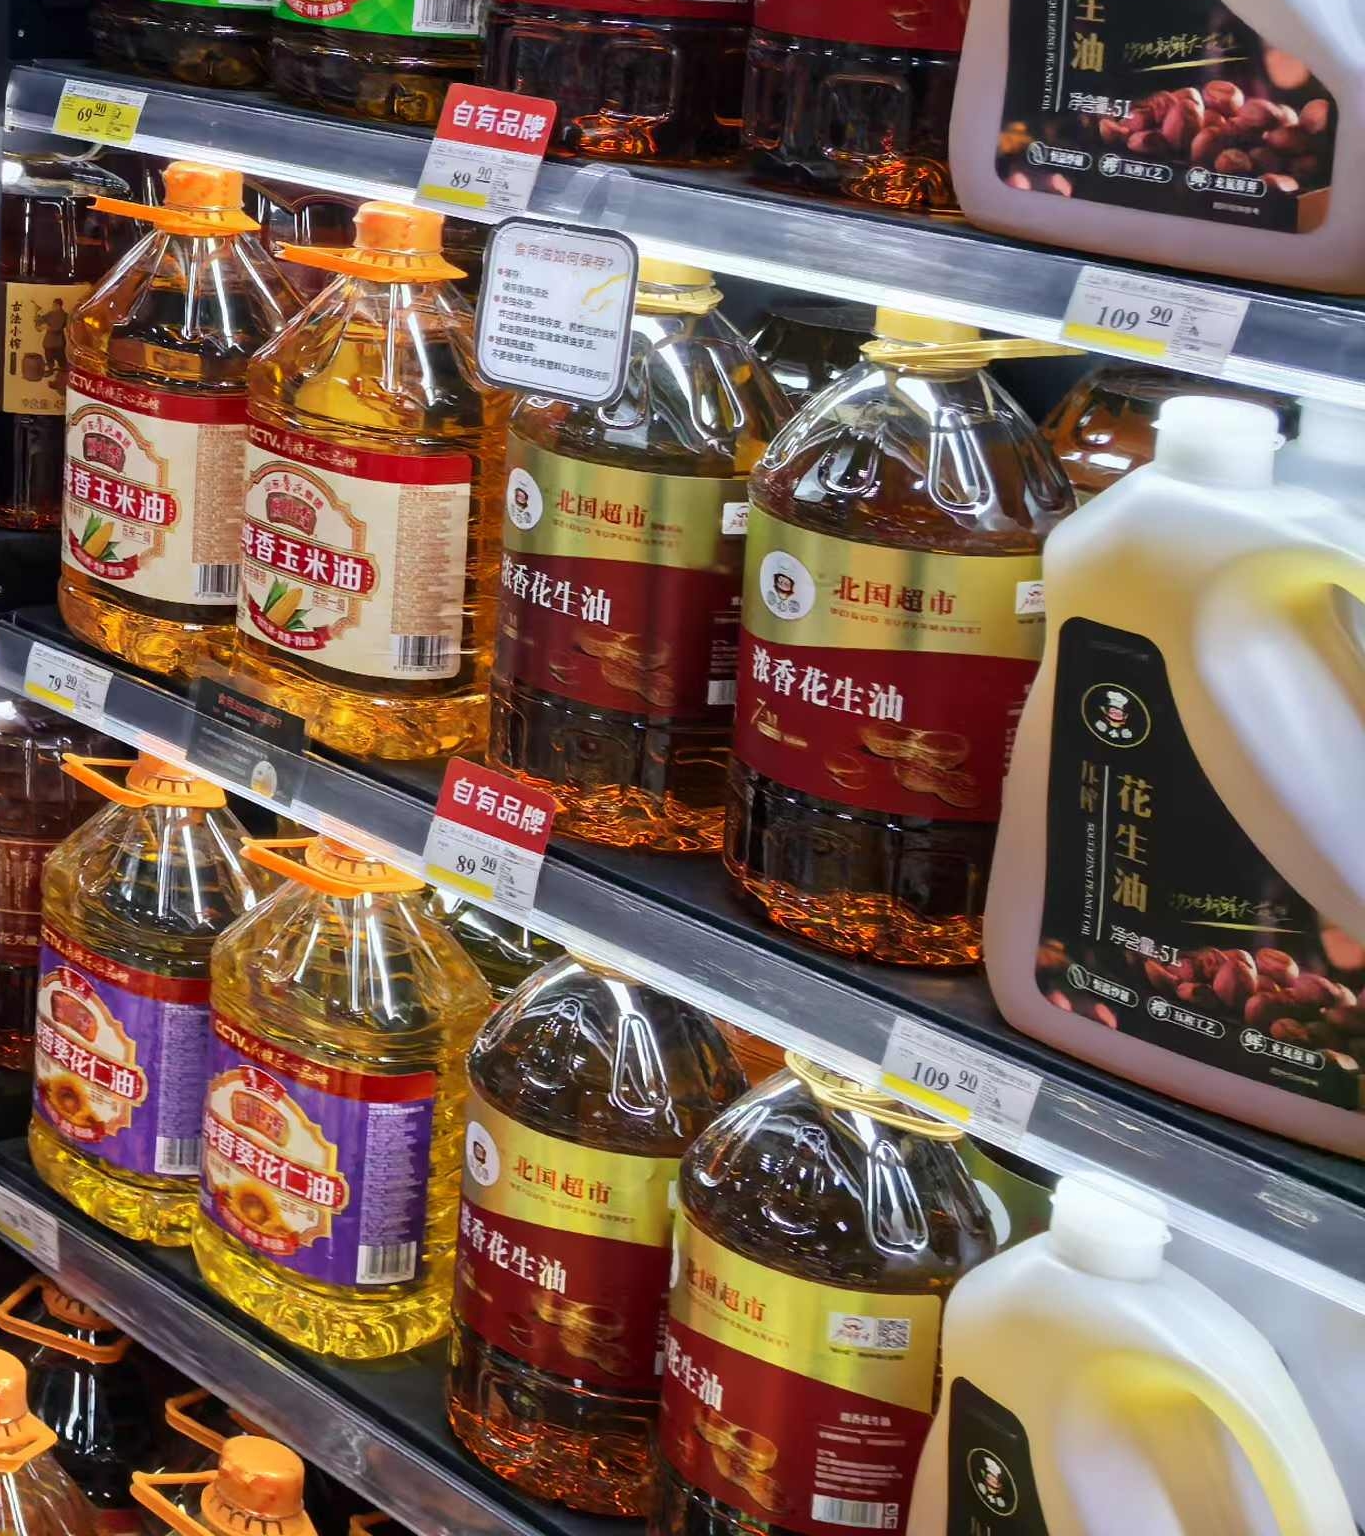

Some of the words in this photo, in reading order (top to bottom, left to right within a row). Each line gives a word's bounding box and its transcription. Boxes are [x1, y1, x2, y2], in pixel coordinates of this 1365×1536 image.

[76, 106, 93, 122] 69
[452, 100, 546, 143] 自有品牌
[451, 169, 471, 189] 89
[1096, 304, 1140, 332] 109
[1149, 305, 1174, 324] 90
[556, 491, 650, 529] 北国超市
[241, 522, 362, 592] 纯香玉米油
[502, 554, 611, 627] 浓香花生油
[834, 575, 957, 616] 北国超市
[48, 674, 62, 692] 79
[752, 644, 905, 724] 浓香花生油
[451, 776, 548, 837] 自有品牌
[1113, 774, 1153, 913] 花生油
[456, 855, 478, 877] 89
[36, 1023, 135, 1099] 香葵花仁油
[910, 1061, 950, 1092] 109
[957, 1070, 979, 1089] 90
[512, 1159, 611, 1206] 北国超市
